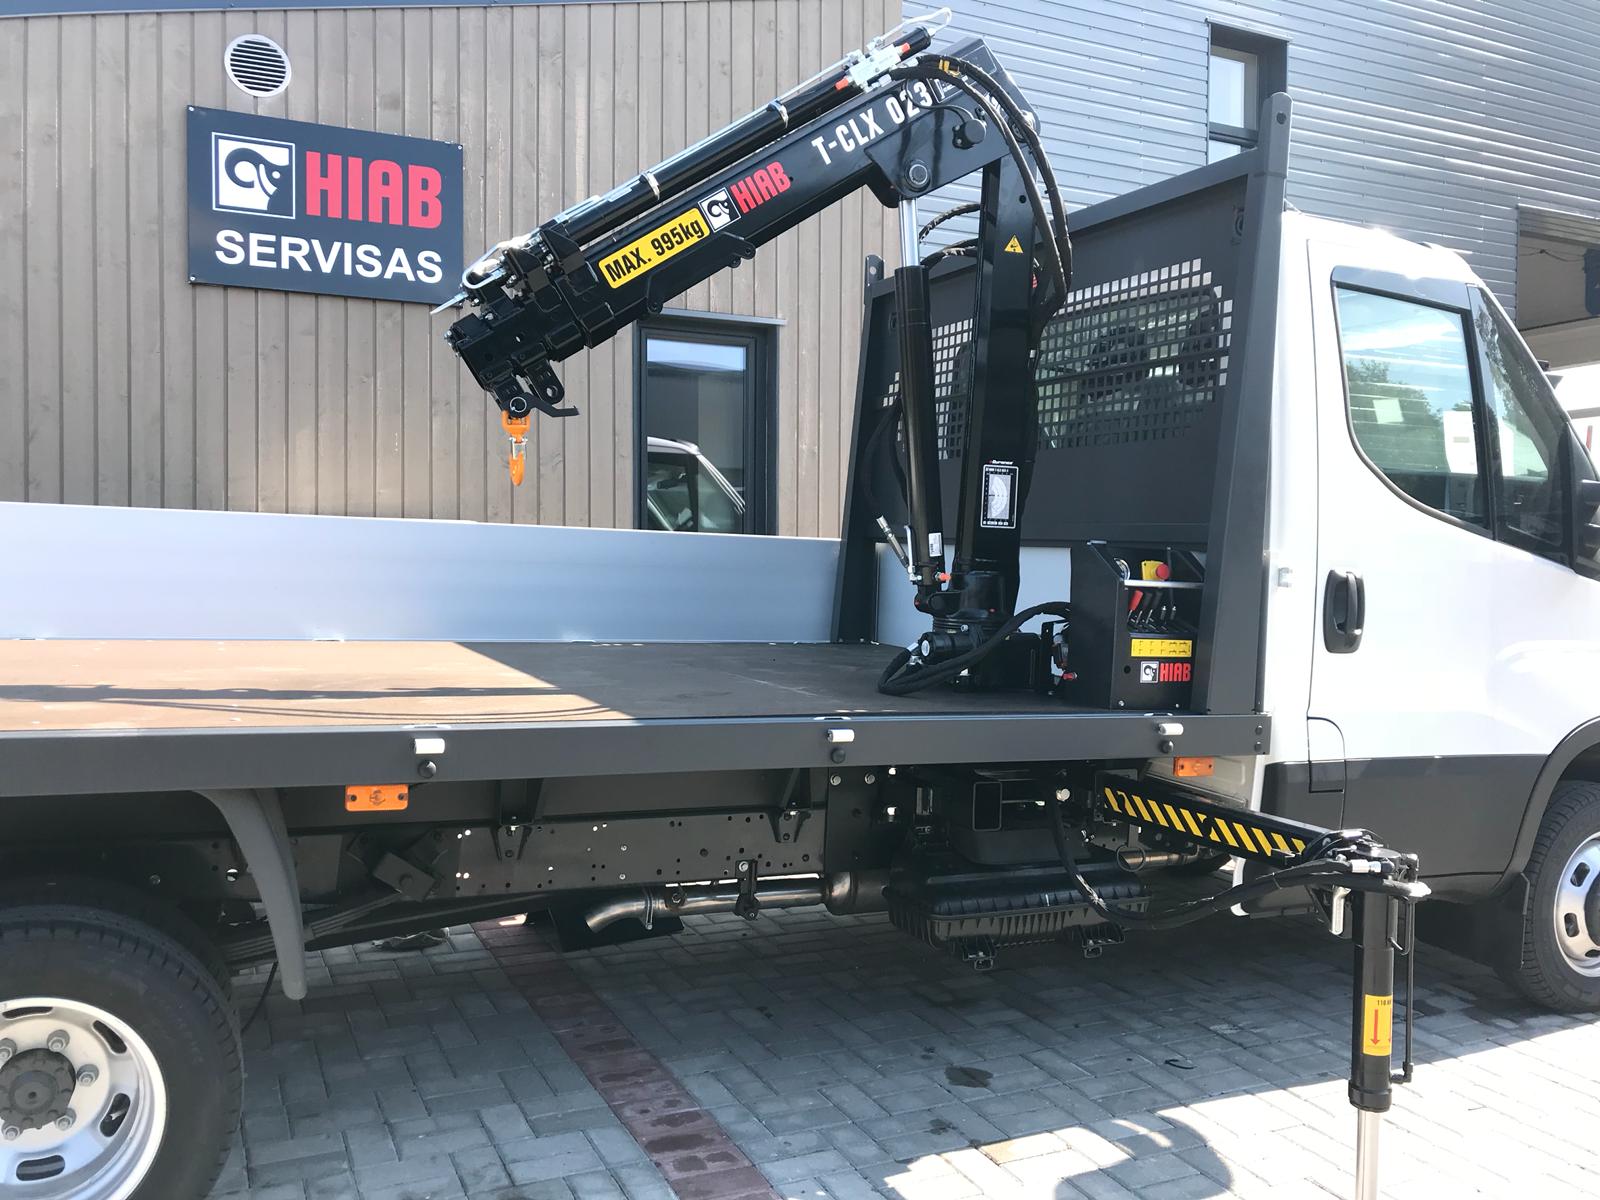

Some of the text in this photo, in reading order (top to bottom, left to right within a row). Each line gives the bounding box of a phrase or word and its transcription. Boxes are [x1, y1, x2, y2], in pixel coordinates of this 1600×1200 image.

[811, 107, 885, 165] T-CLX
[885, 81, 933, 125] 023
[305, 150, 442, 230] HIAB
[730, 161, 791, 214] HIAB
[214, 229, 443, 285] SERVISAS
[604, 218, 705, 283] MAX. 995kg
[1159, 662, 1192, 682] HIAB
